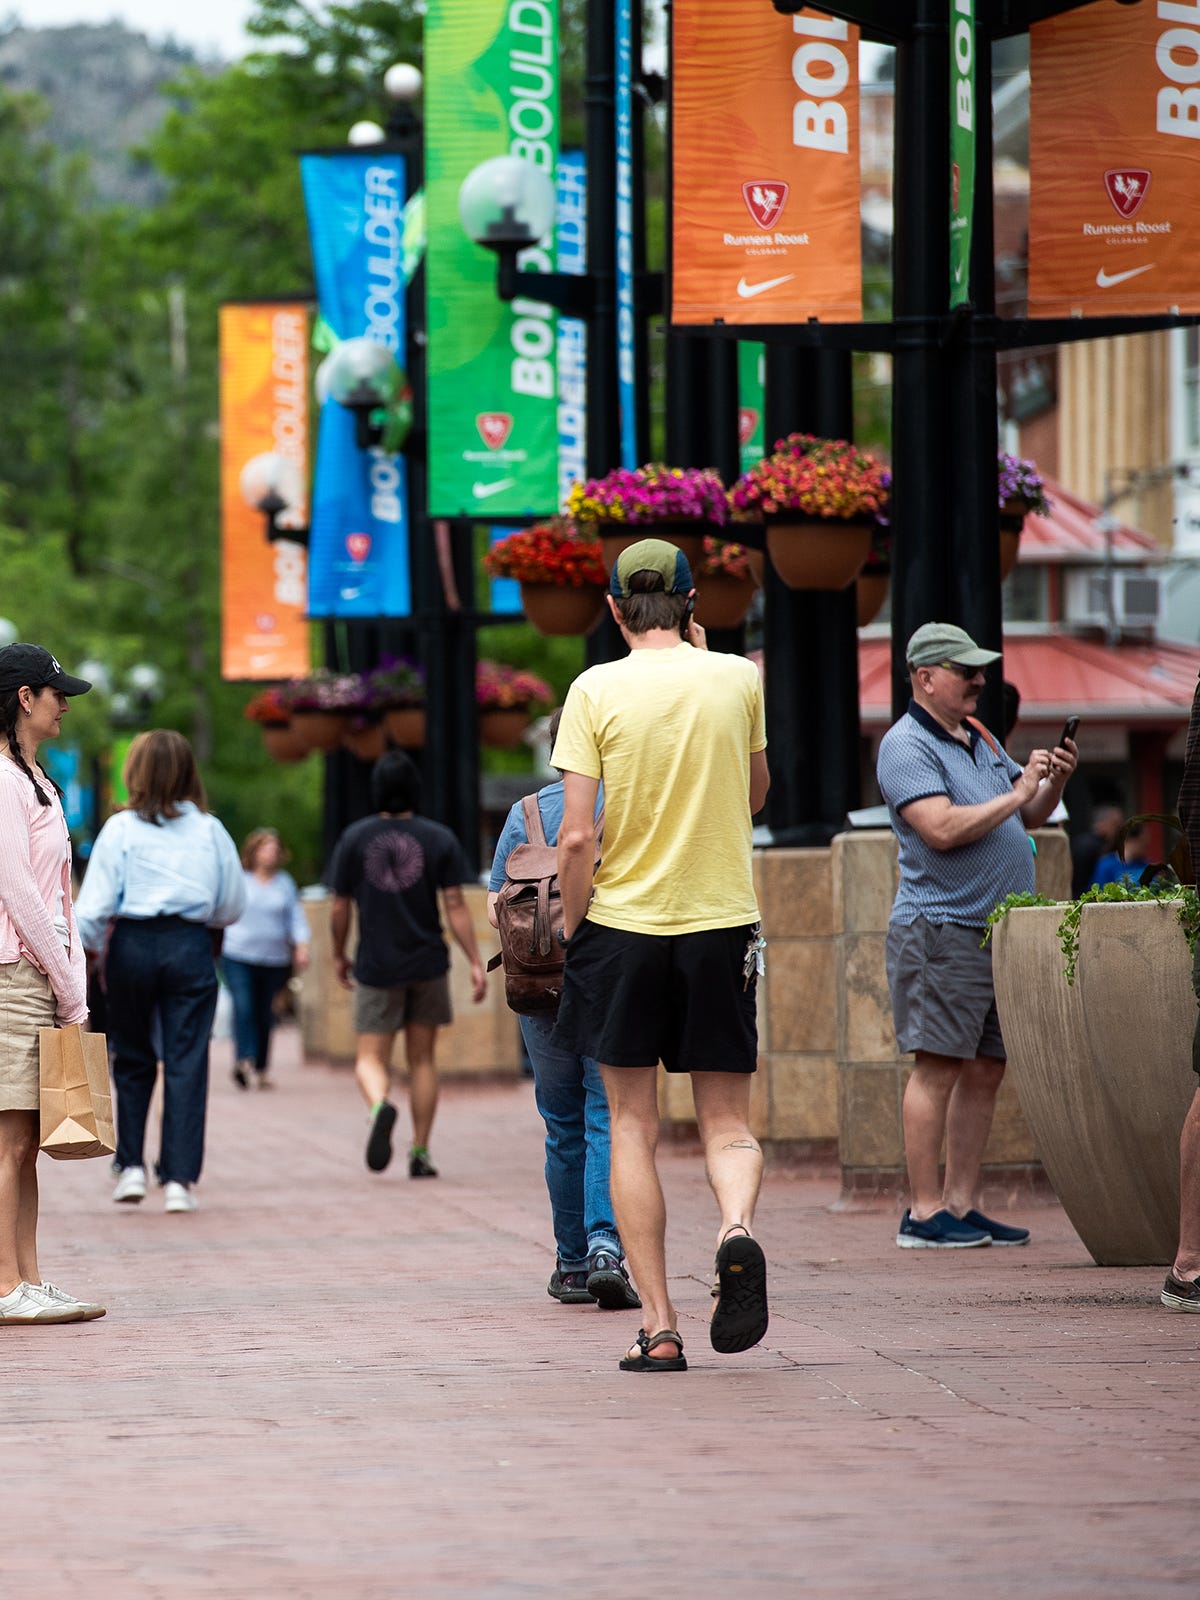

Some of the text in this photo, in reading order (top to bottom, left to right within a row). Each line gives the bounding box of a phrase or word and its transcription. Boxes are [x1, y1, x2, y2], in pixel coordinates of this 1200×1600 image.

[1083, 221, 1171, 235] Runners Roost
[723, 232, 809, 245] Runners Roost
